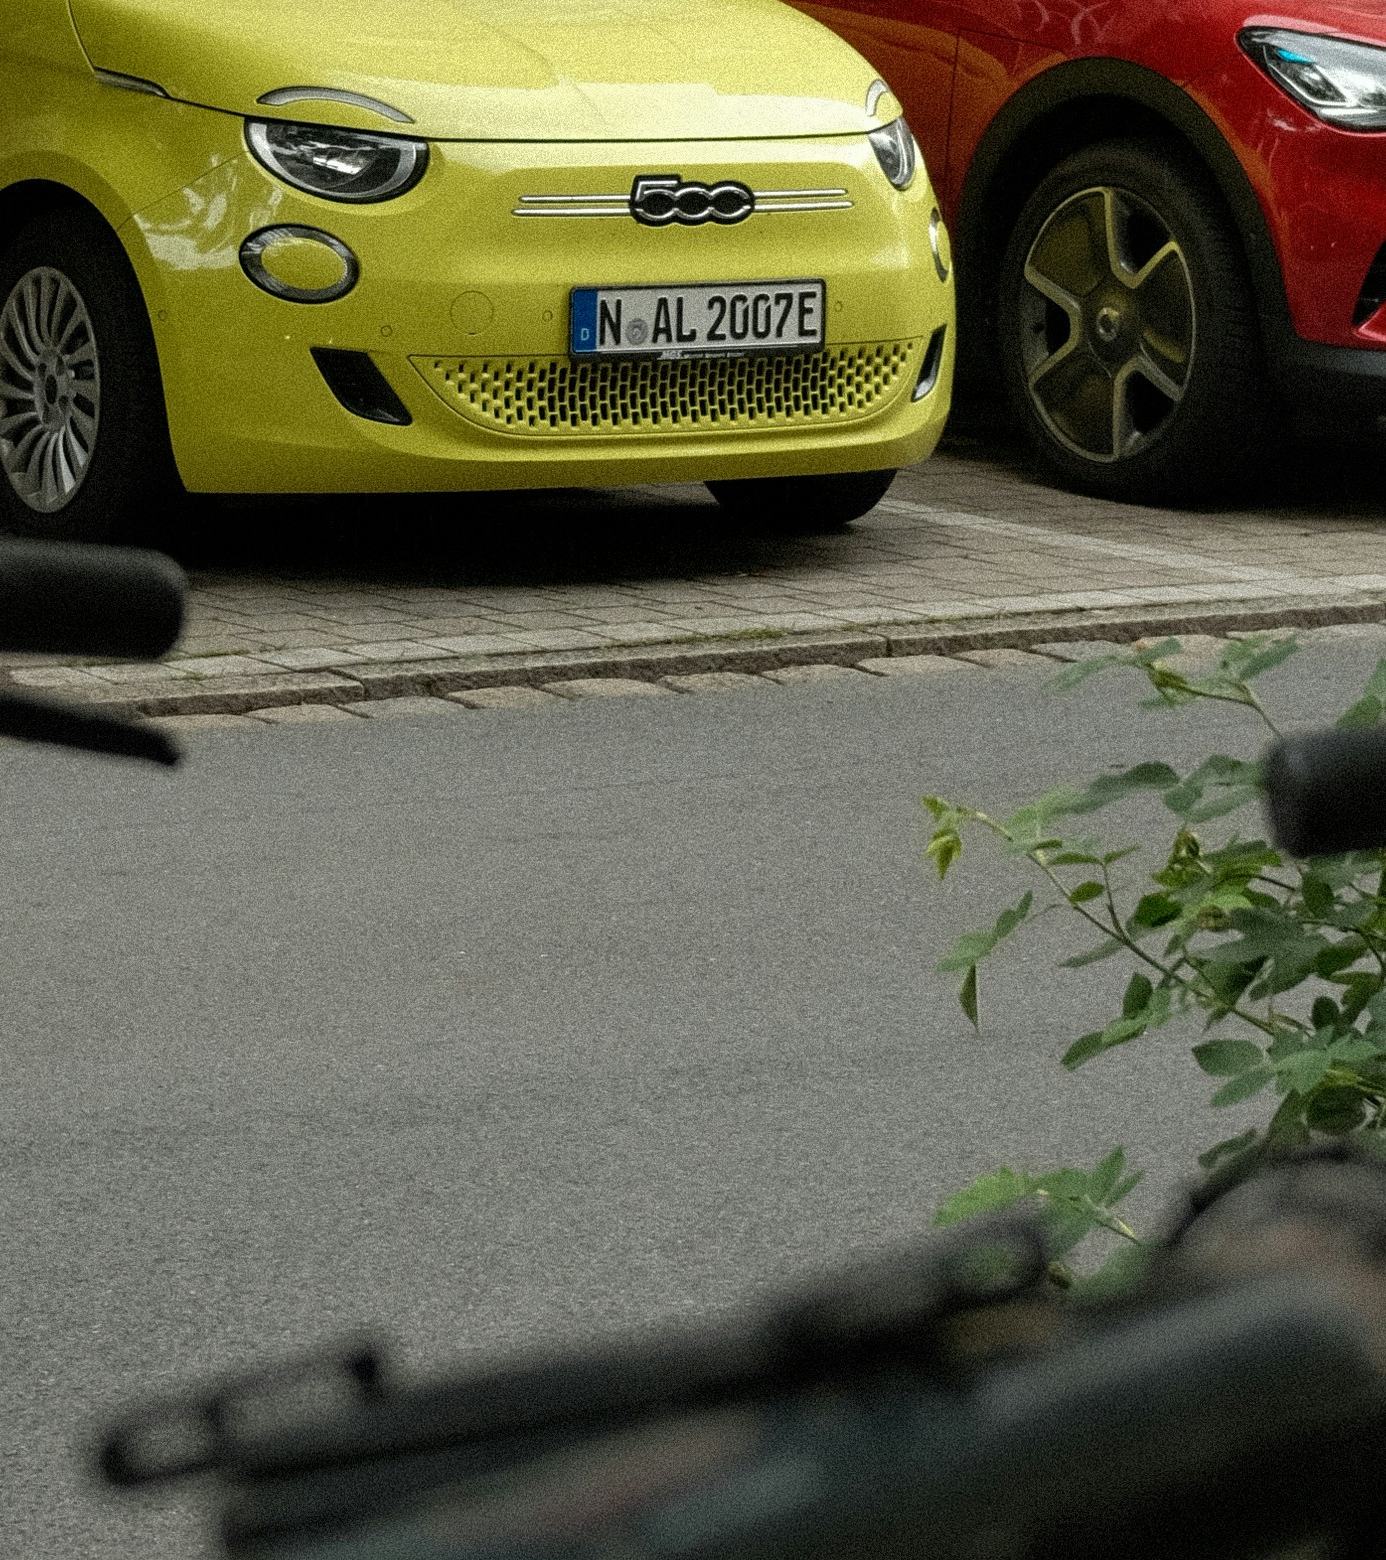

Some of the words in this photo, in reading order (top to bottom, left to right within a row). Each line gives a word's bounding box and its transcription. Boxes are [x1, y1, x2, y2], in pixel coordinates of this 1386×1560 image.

[632, 178, 753, 222] 500
[580, 327, 590, 341] D
[599, 298, 622, 346] N
[651, 296, 697, 344] AL
[706, 291, 818, 341] 2007E
